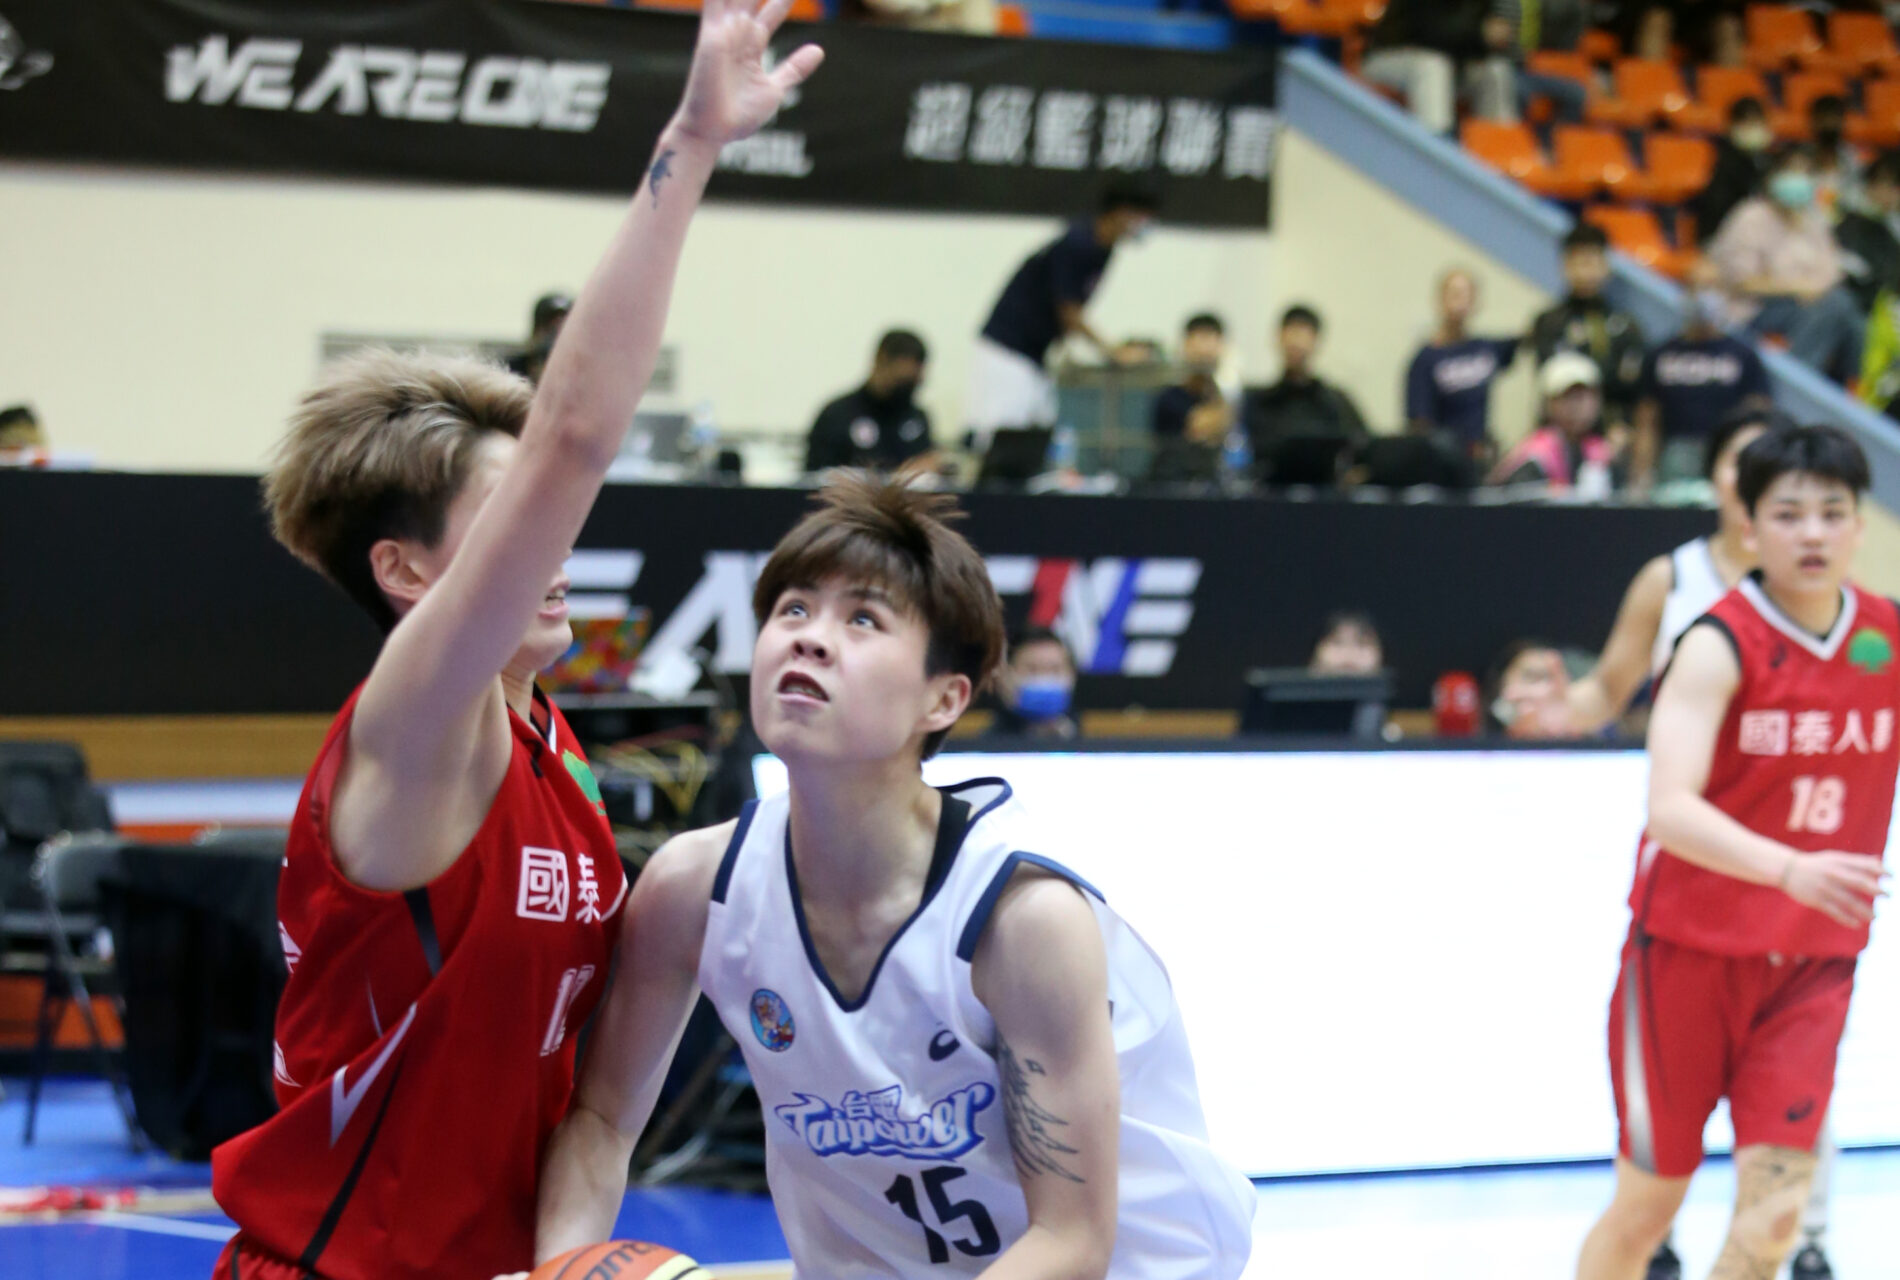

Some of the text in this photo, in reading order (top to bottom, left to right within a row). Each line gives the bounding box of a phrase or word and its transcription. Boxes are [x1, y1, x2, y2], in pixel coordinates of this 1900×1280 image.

[164, 34, 612, 133] WE ARE ONE
[1786, 774, 1846, 835] 18
[774, 1081, 996, 1162] Taipower
[884, 1165, 1001, 1264] 15
